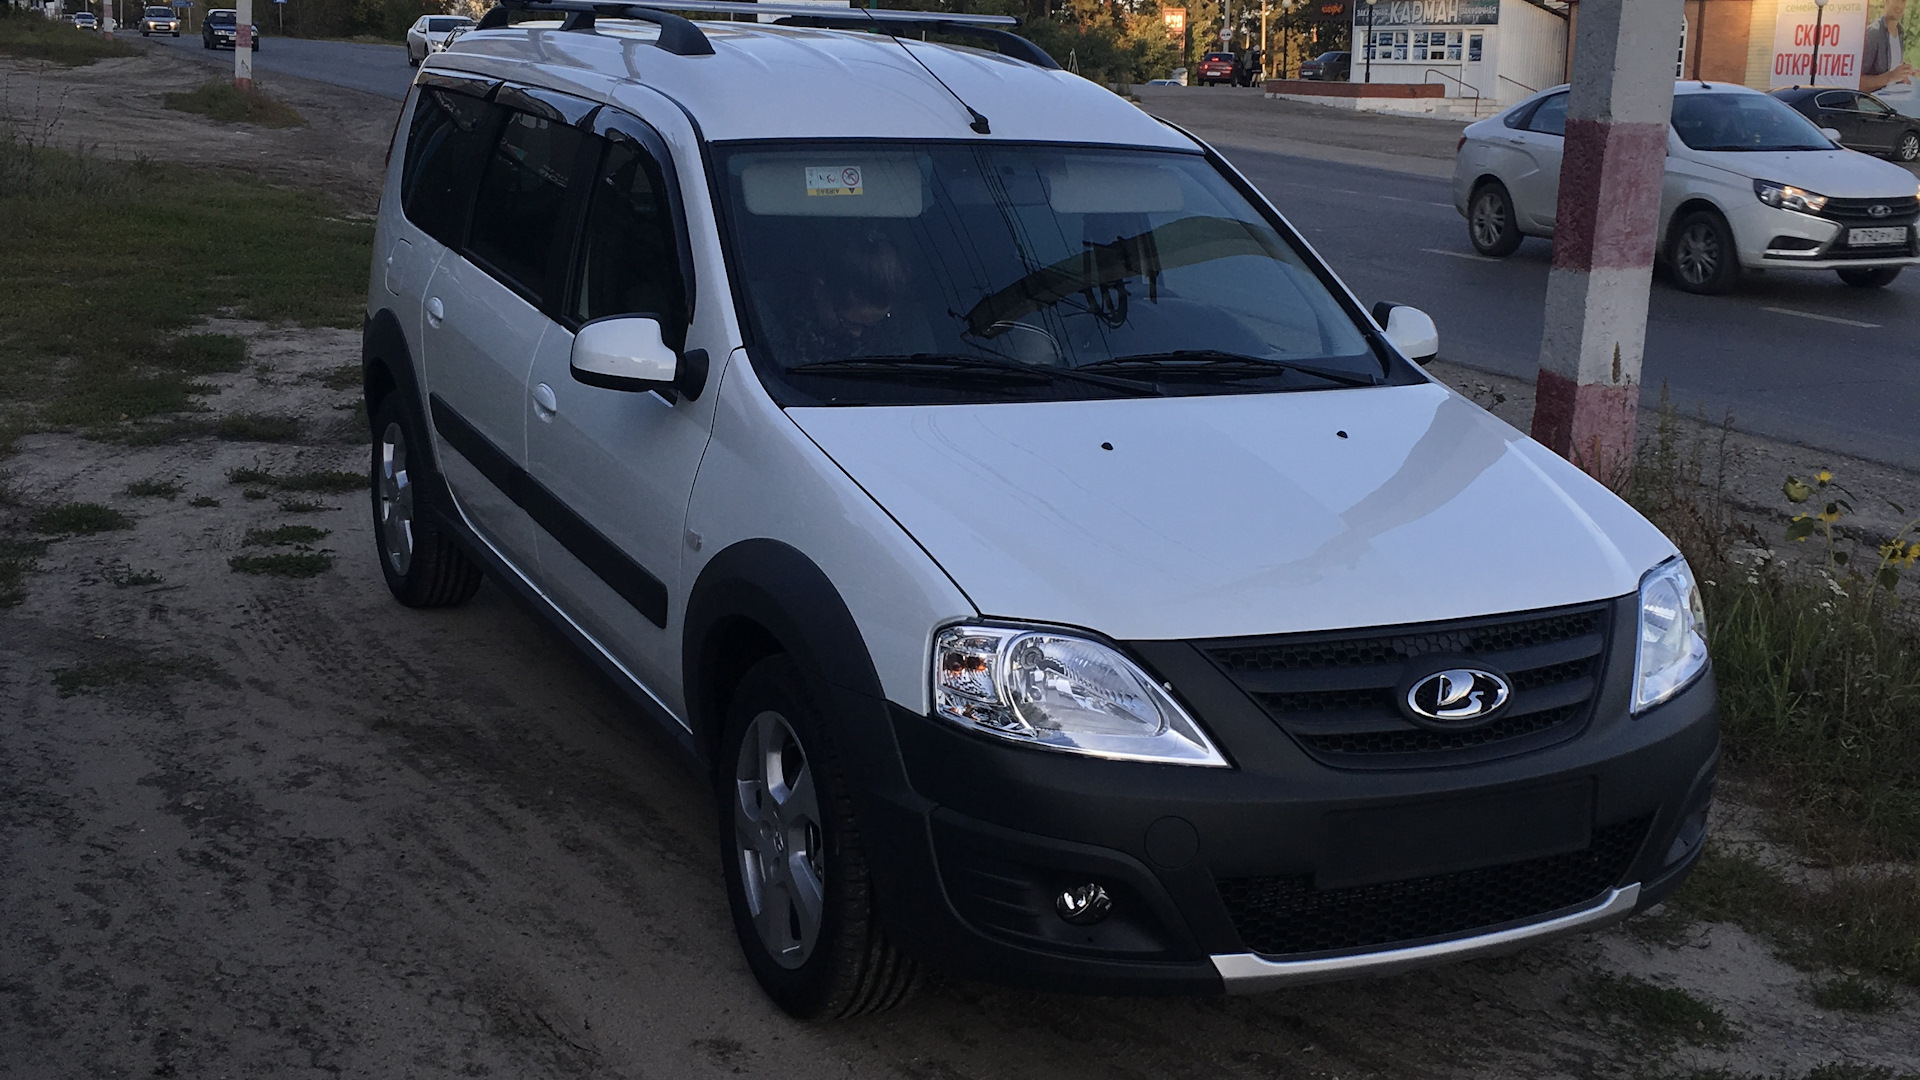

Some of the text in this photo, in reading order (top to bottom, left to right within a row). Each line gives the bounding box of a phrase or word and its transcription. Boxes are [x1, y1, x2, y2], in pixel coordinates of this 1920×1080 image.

[1390, 0, 1459, 23] КАРМАН
[1786, 3, 1861, 13] семейнго уюта
[1794, 24, 1840, 46] СКОРО
[1775, 54, 1855, 76] ОТКРЫТИЕ!
